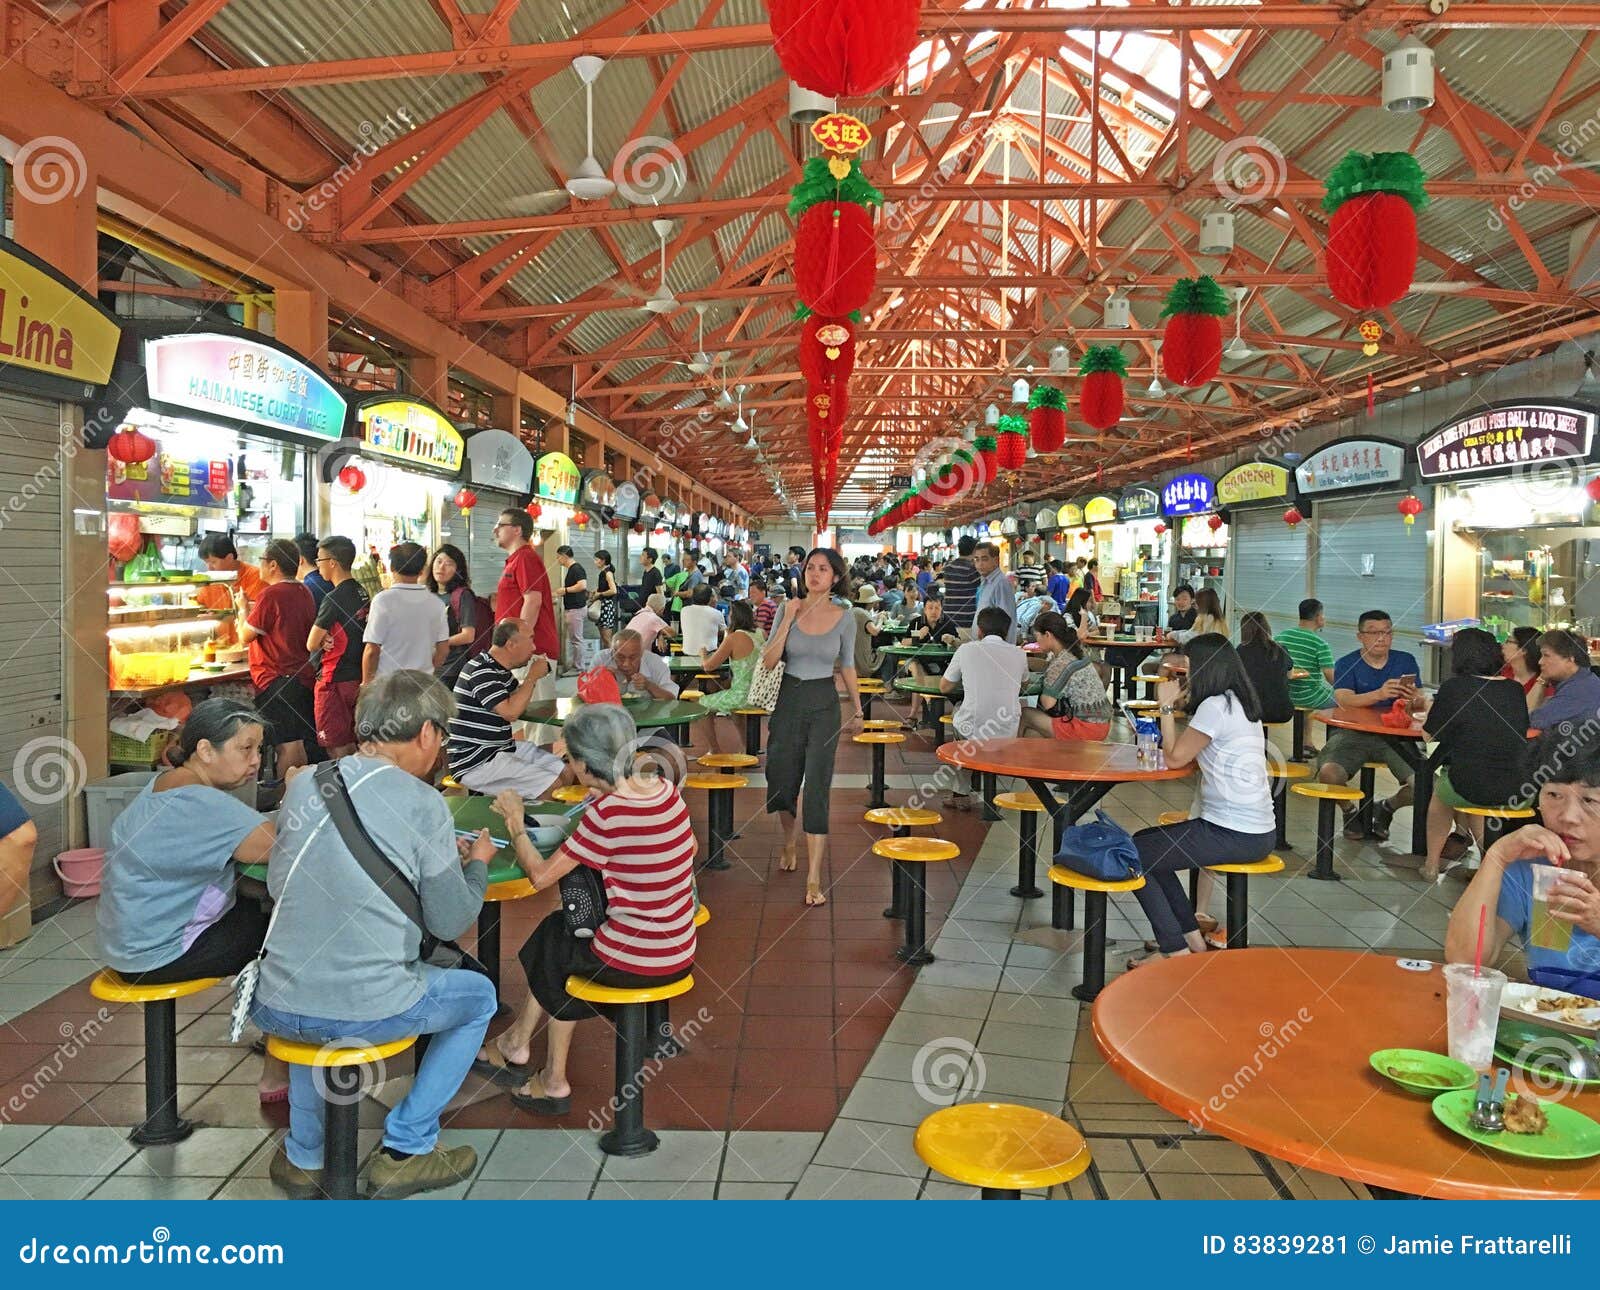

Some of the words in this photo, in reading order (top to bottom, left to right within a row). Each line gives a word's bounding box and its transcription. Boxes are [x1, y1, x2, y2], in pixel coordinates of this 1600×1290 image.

[819, 120, 863, 145] 大旺
[189, 375, 264, 413] HAINANESE
[267, 399, 303, 424] CURRY
[305, 408, 327, 430] RICE
[1508, 411, 1529, 428] BALL
[1530, 412, 1538, 428] &
